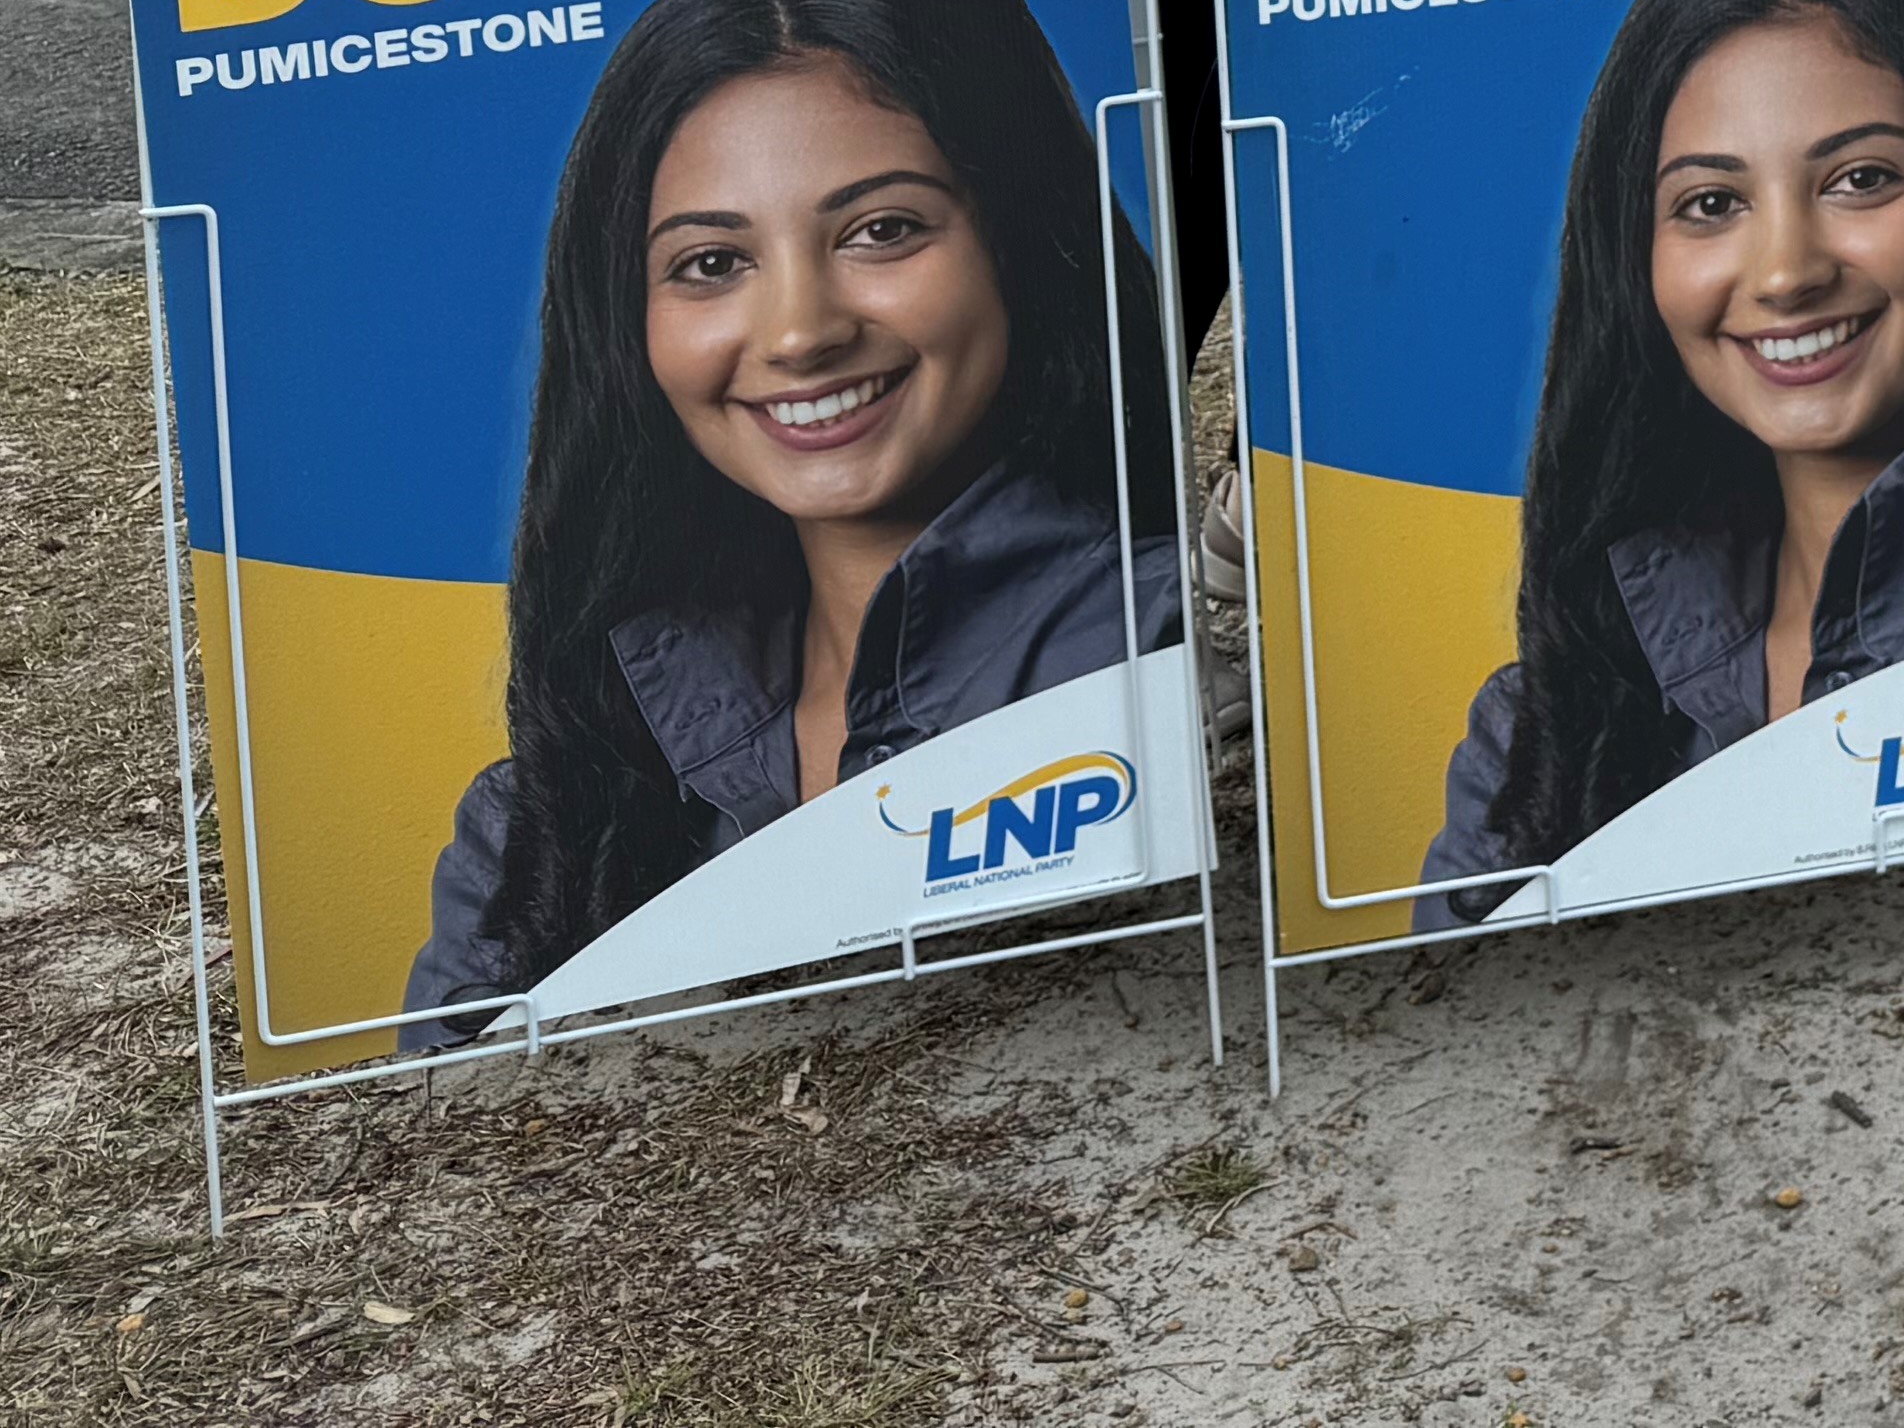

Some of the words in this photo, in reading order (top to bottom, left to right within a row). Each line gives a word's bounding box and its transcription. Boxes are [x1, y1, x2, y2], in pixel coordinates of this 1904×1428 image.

[173, 2, 606, 97] PUMICESTONE
[923, 879, 971, 898] LIBERAL
[973, 865, 1033, 887] NATIONAL
[1034, 855, 1075, 873] PARTY
[925, 775, 1121, 883] LNP
